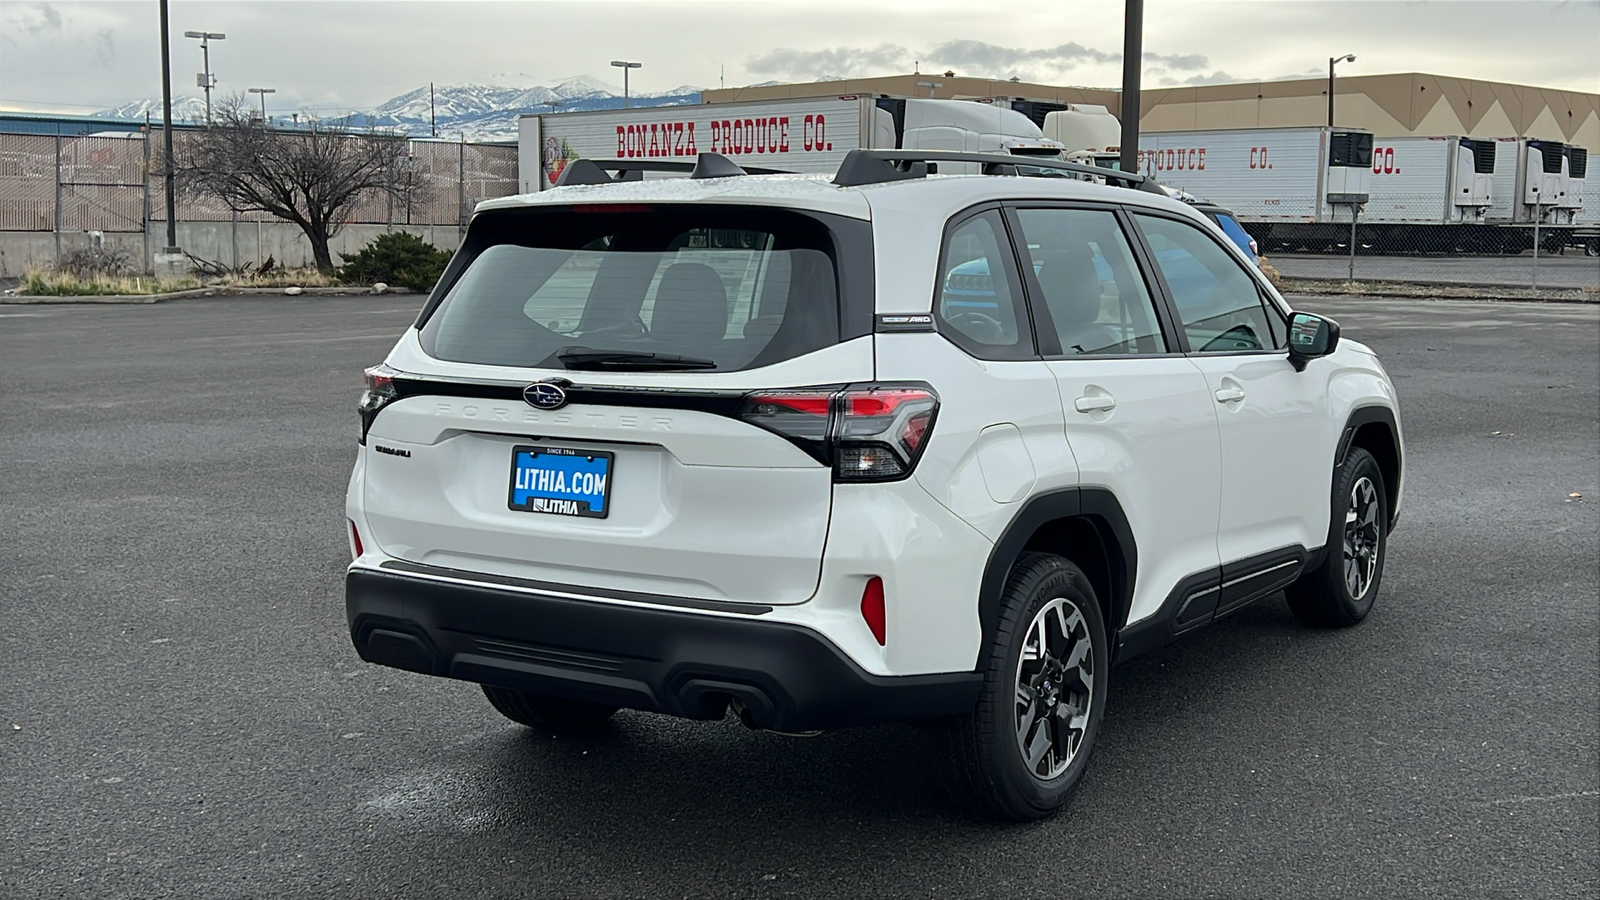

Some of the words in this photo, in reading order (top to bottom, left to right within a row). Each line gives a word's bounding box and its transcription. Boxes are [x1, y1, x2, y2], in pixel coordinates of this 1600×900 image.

[616, 122, 697, 158] BONANZA
[711, 117, 789, 154] PRODUCE
[804, 114, 832, 151] CO.
[1250, 147, 1273, 169] CO.
[1373, 148, 1400, 174] CO.
[436, 403, 673, 431] FORESTER
[515, 467, 606, 496] LITHIA.COM
[543, 498, 578, 515] LITHIA
